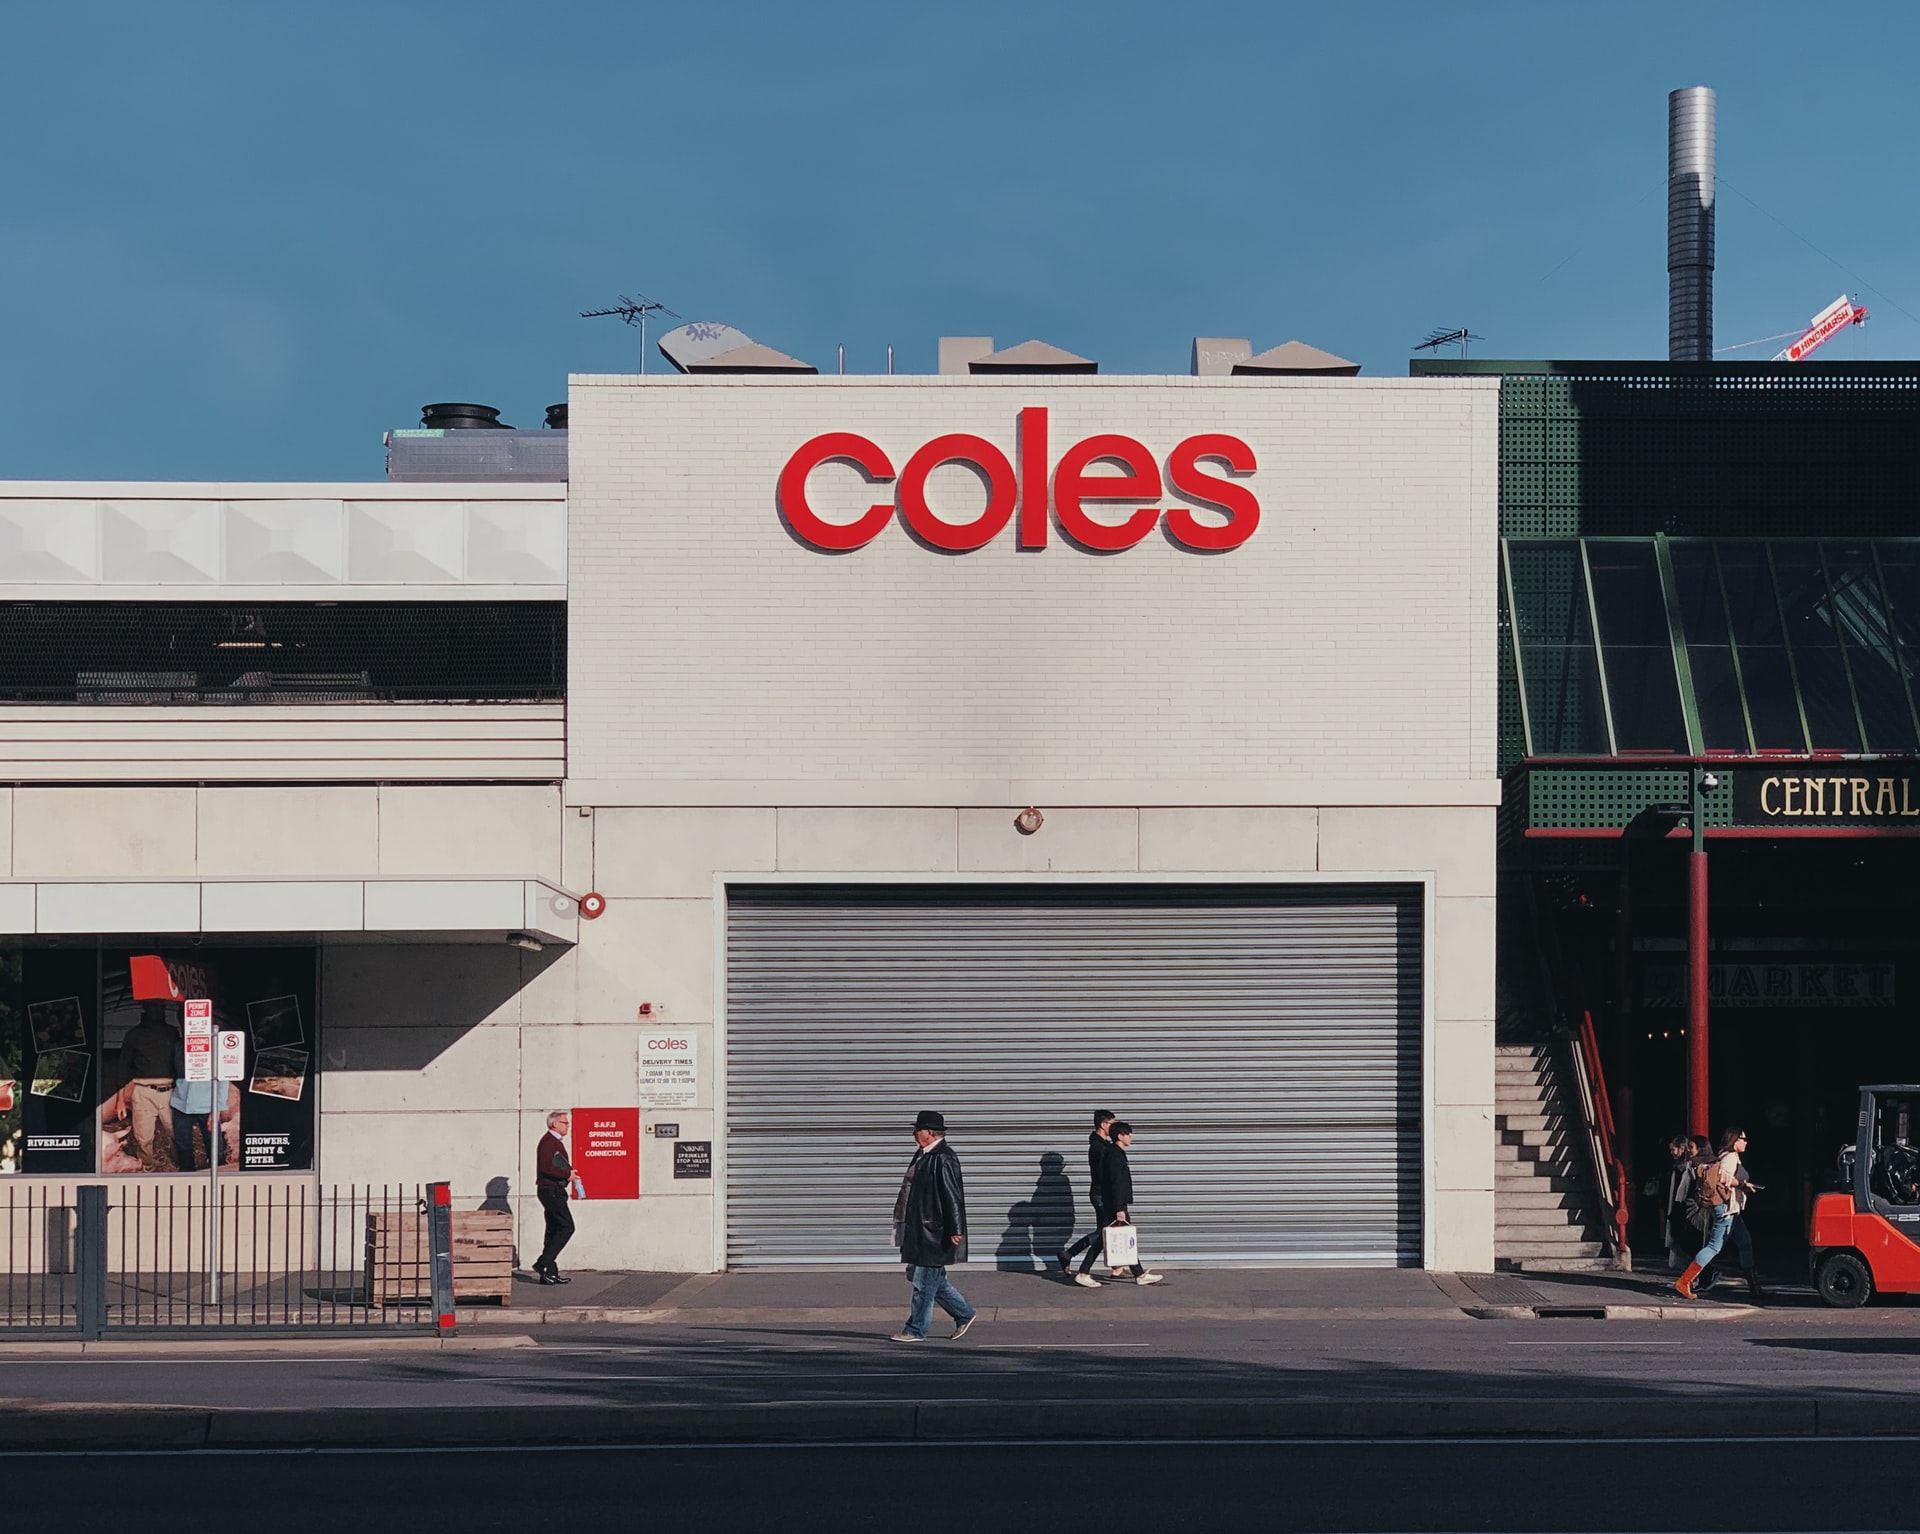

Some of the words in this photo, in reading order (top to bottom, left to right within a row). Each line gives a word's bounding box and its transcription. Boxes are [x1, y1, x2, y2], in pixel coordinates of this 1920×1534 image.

[1801, 309, 1848, 351] HINDMARSH
[778, 406, 1261, 553] coles
[1760, 776, 1920, 816] CENTRAL
[190, 1009, 206, 1017] ZONE
[647, 1037, 688, 1050] coles
[190, 1044, 205, 1052] ZONE
[27, 1139, 80, 1147] RIVERLAND
[245, 1137, 290, 1145] GROWERS,
[245, 1146, 276, 1155] JENNY
[277, 1146, 285, 1154] &
[245, 1156, 274, 1164] PETER
